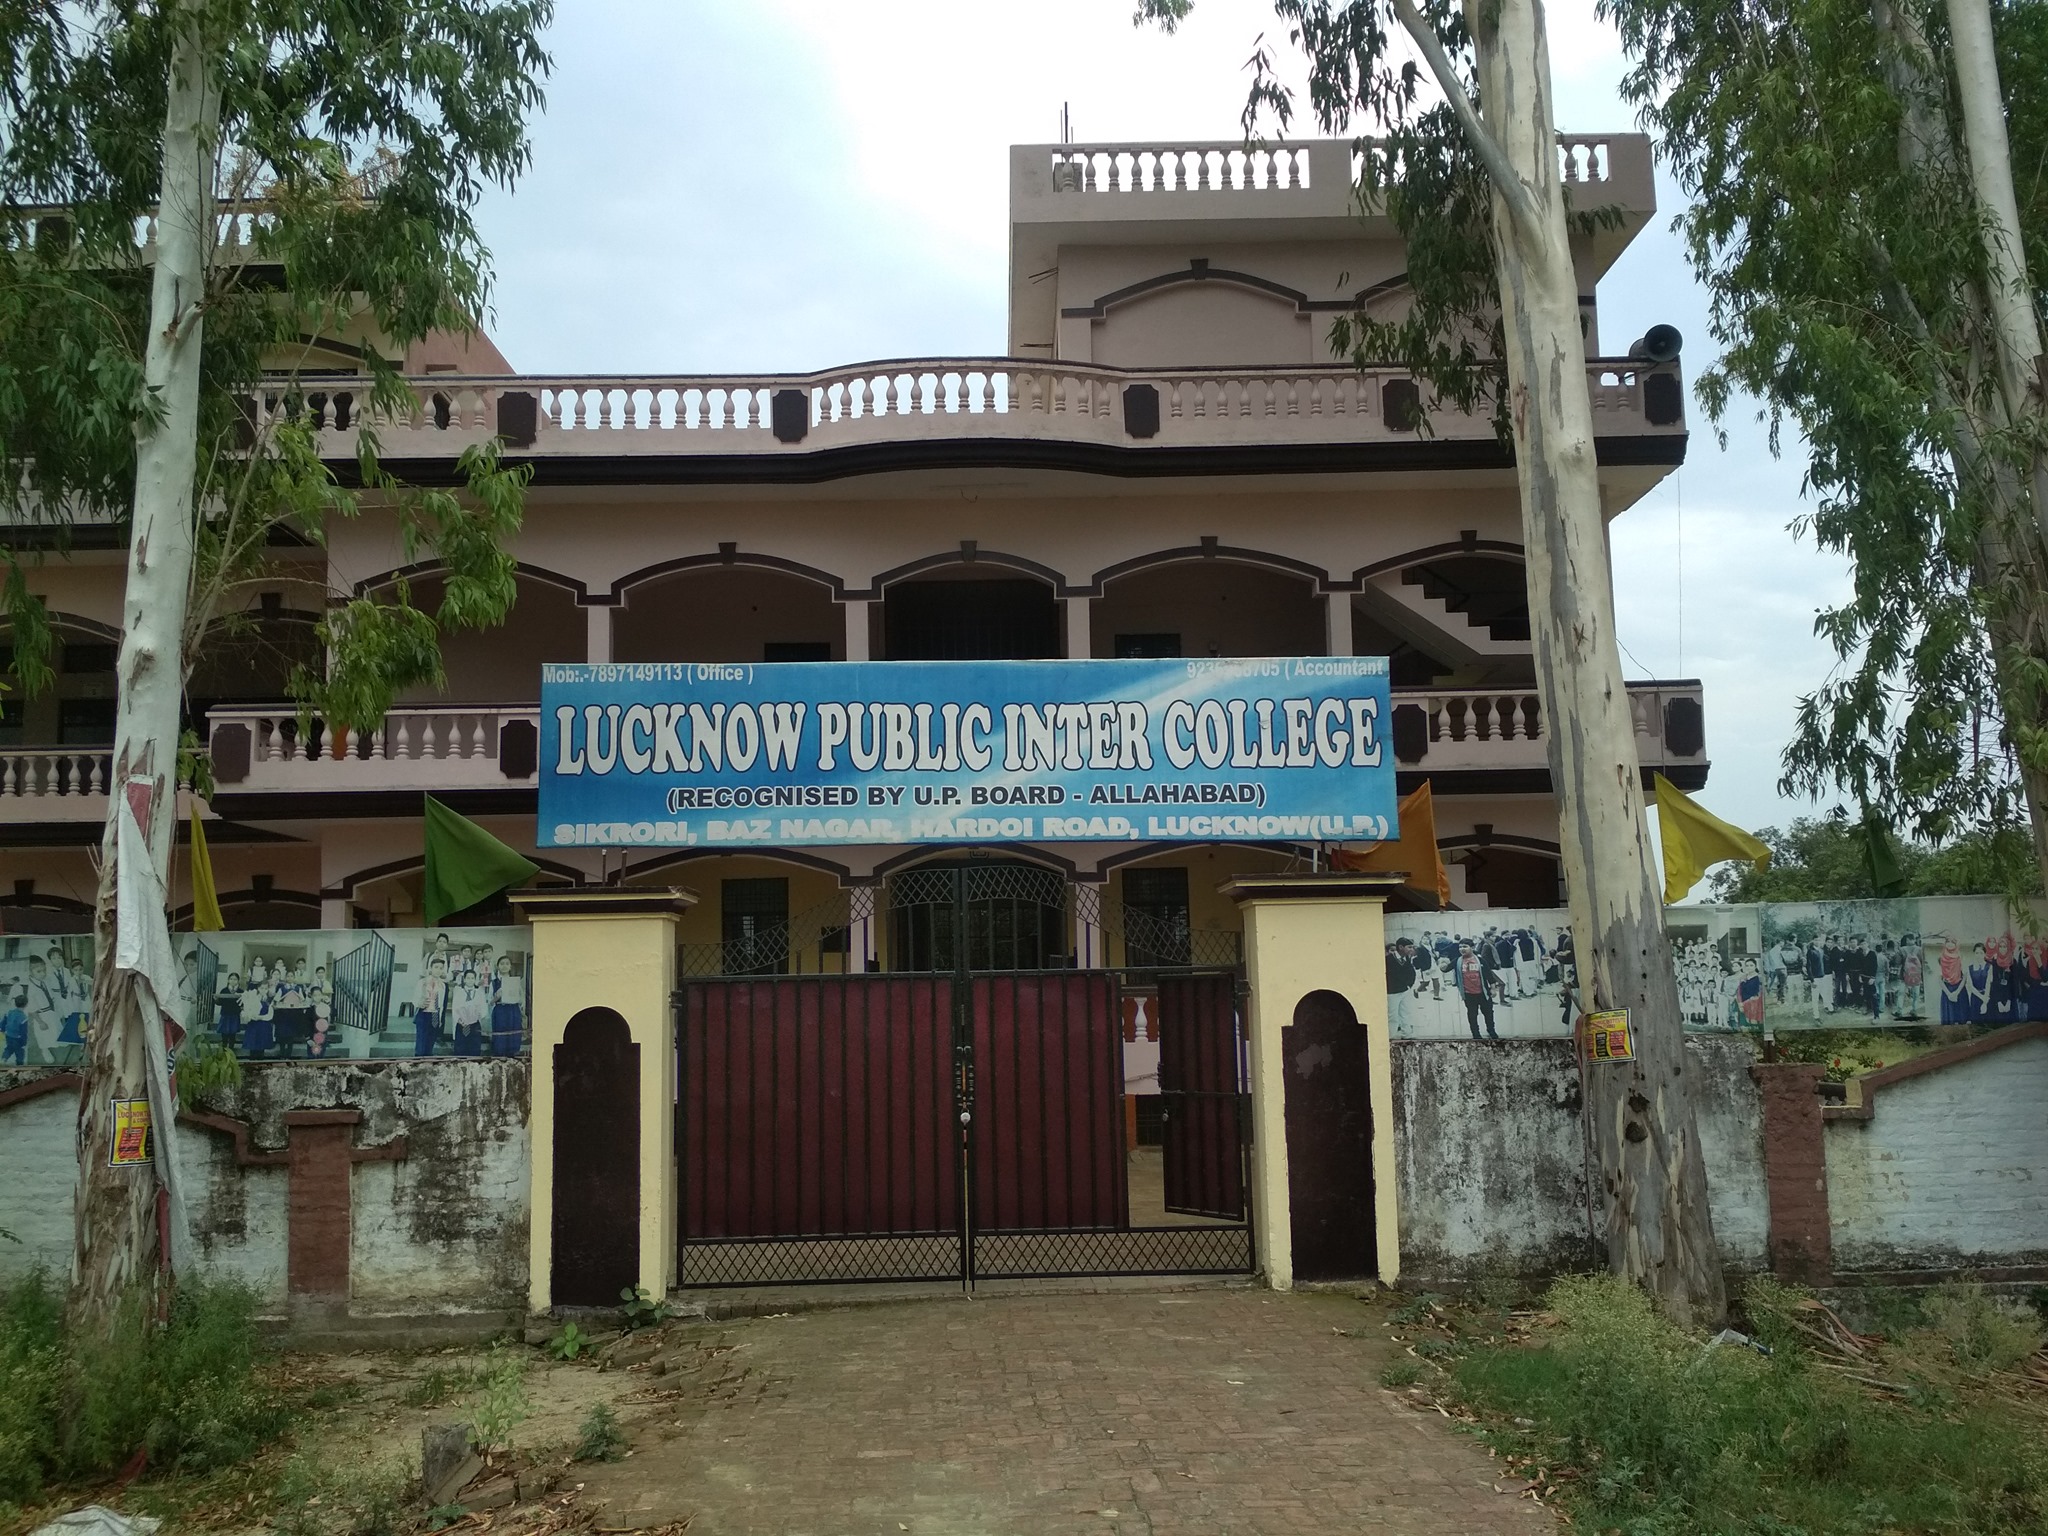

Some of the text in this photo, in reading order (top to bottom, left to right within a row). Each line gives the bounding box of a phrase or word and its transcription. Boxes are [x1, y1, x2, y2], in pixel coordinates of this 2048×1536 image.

[697, 664, 744, 681] Office
[1294, 659, 1384, 677] Accountant
[555, 697, 1382, 776] LUCKNOW PUBLIC INTER COLLEGE
[666, 786, 859, 814] (RECOGNISED
[867, 786, 906, 806] BY
[913, 786, 961, 806] U.P.
[970, 785, 1066, 806] BOARD
[1089, 782, 1267, 808] ALLAHABAD)
[553, 821, 698, 845] SIKRORI,
[706, 819, 773, 841] BAZ
[910, 817, 1034, 839] HARDOI
[1042, 815, 1140, 840] ROAD,
